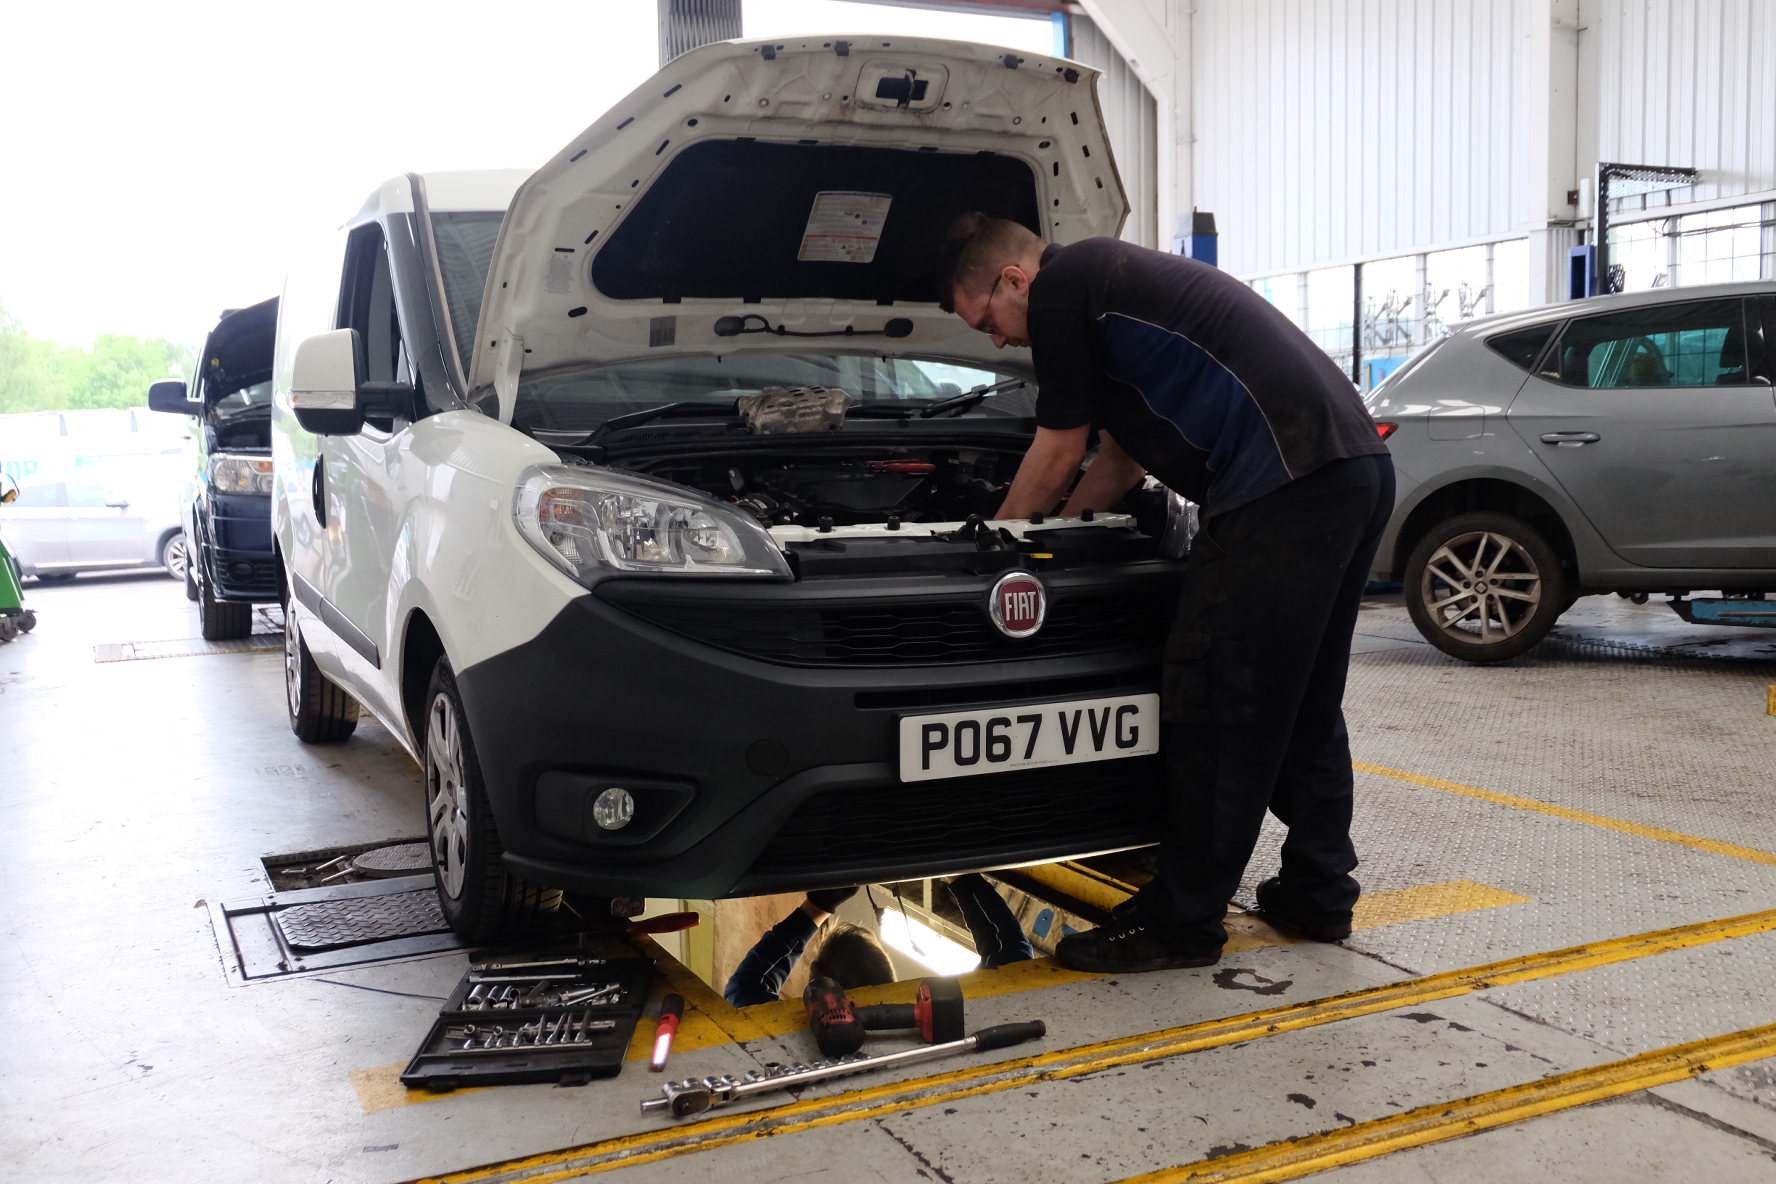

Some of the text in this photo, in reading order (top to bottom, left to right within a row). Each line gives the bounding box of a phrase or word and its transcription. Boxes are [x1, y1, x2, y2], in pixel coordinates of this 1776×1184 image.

[1004, 591, 1036, 621] FIAT
[922, 704, 1139, 770] PO67 VVG
